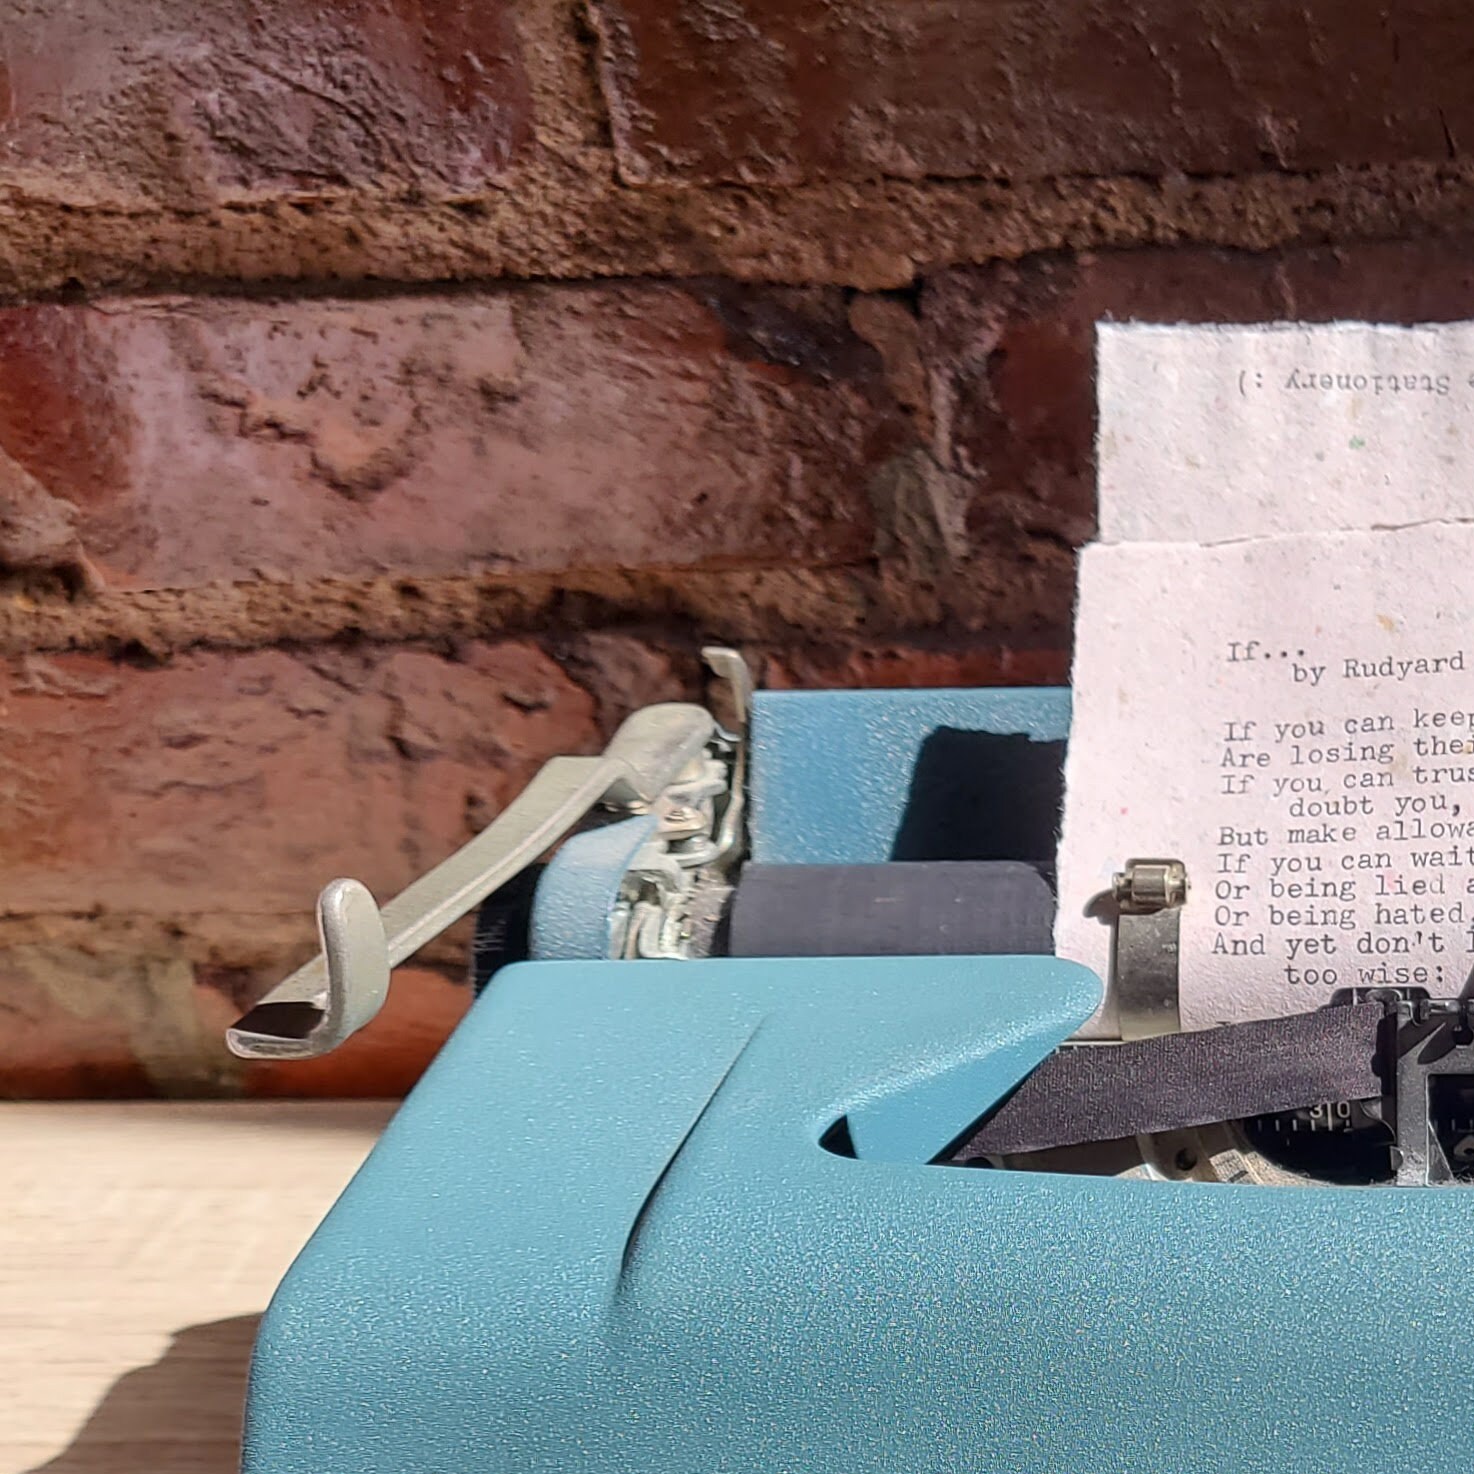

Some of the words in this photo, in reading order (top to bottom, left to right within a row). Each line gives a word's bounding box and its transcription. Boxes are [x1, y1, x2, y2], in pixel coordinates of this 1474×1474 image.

[1286, 368, 1450, 395] Stationery
[1227, 640, 1305, 662] If...
[1292, 663, 1326, 687] by
[1343, 650, 1465, 681] Rudyard
[1224, 721, 1257, 742] If
[1275, 720, 1325, 744] you
[1344, 715, 1395, 735] can
[1221, 747, 1271, 768] Are
[1291, 741, 1395, 765] losing
[1221, 774, 1255, 795] If
[1273, 777, 1322, 798] you
[1343, 771, 1394, 789] can
[1289, 795, 1374, 818] doubt
[1394, 794, 1461, 818] you,
[1217, 826, 1269, 847] But
[1287, 822, 1357, 844] make
[1217, 853, 1251, 874] If
[1270, 856, 1323, 877] you
[1341, 852, 1392, 871] can
[1215, 879, 1251, 900] Or
[1269, 876, 1357, 903] being
[1375, 873, 1446, 896] lied
[1214, 905, 1250, 927] Or
[1268, 904, 1356, 931] being
[1211, 932, 1266, 956] And
[1285, 933, 1337, 961] yet
[1356, 930, 1445, 955] don't
[1283, 964, 1338, 986] too
[1357, 965, 1443, 985] wise:
